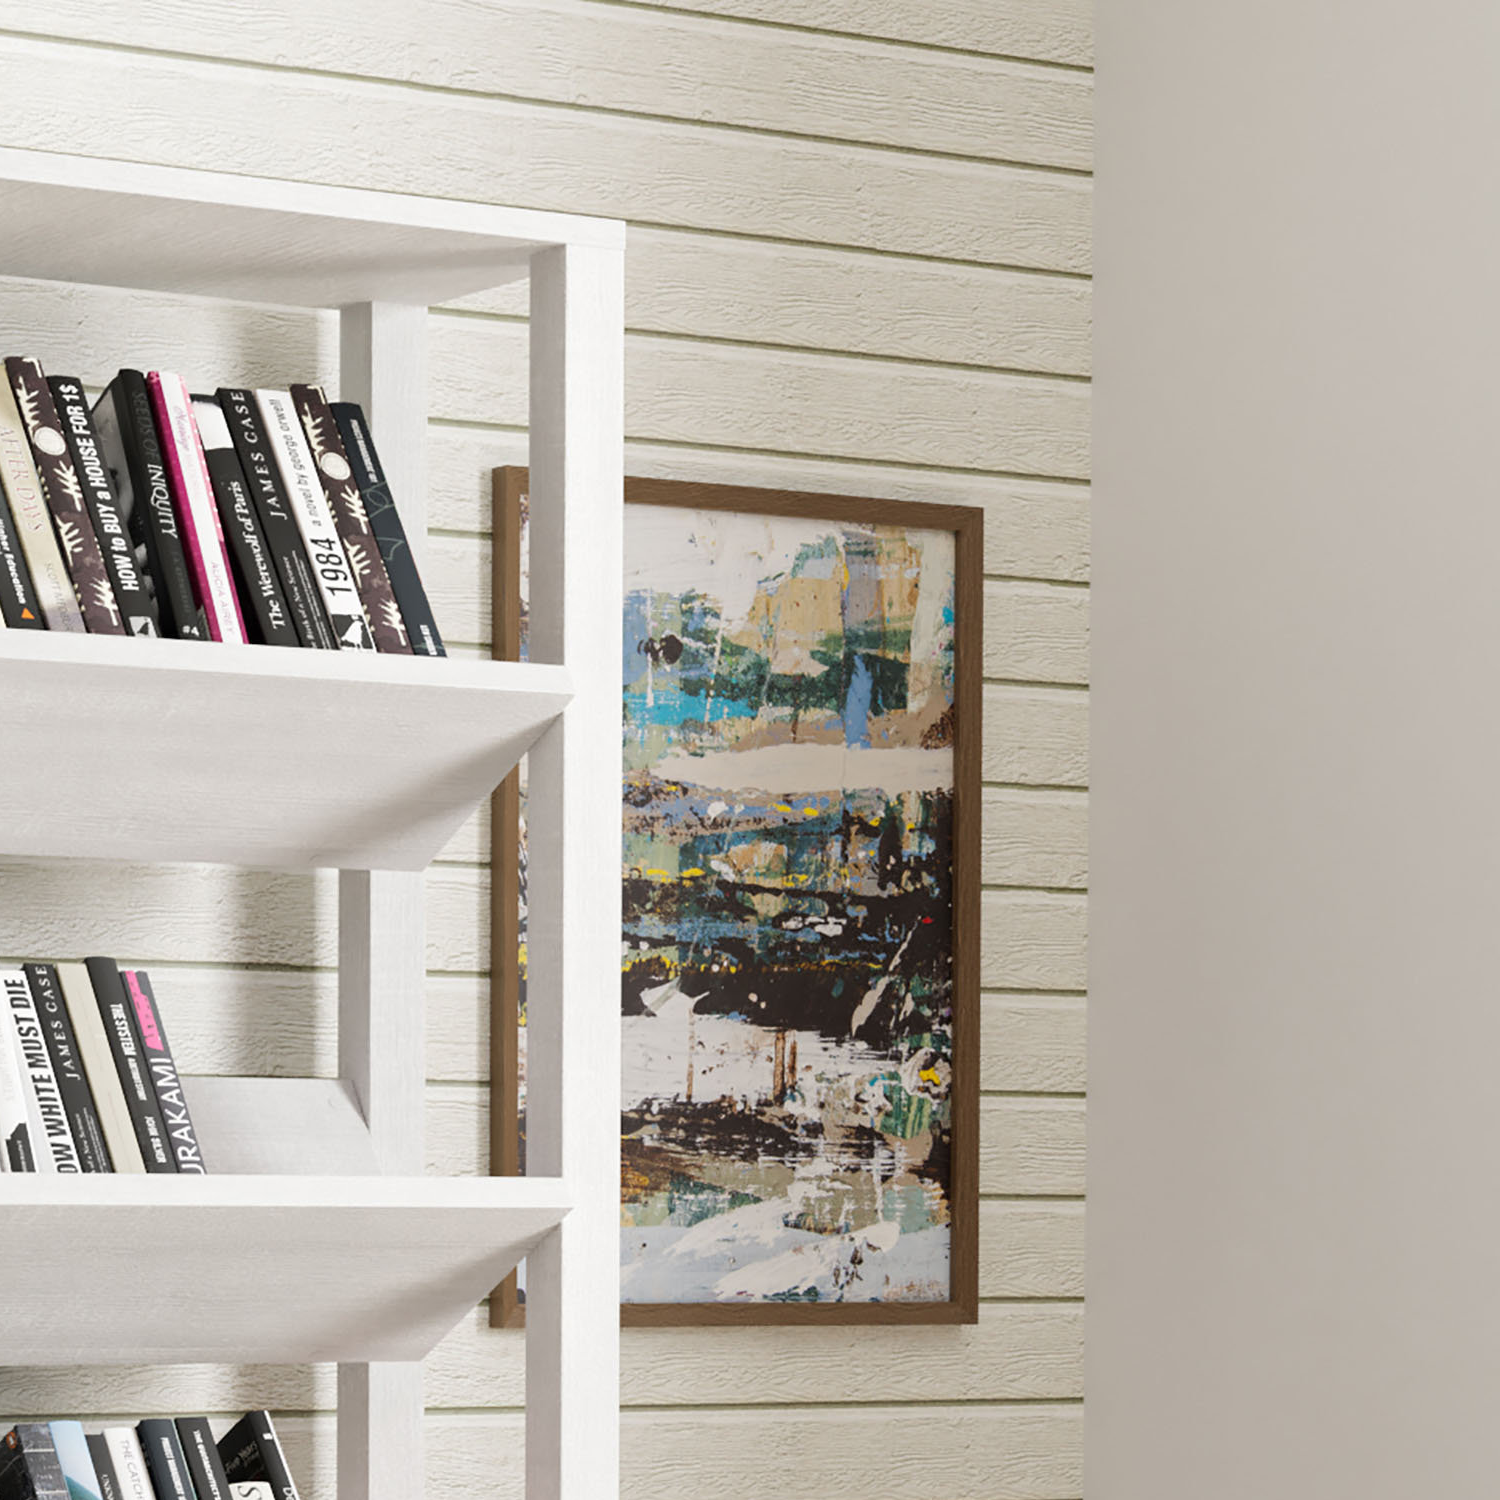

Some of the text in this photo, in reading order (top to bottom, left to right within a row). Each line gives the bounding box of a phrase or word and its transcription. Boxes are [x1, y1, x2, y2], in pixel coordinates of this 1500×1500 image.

[268, 398, 291, 432] orwell
[282, 434, 306, 471] george
[0, 426, 46, 533] AFTER DAYS
[58, 384, 140, 591] HOW to BUY a HOUSE FOR 1$
[147, 463, 178, 539] INIQUITY
[250, 452, 288, 521] JAMES
[297, 474, 308, 486] by
[298, 487, 318, 517] novel
[311, 519, 322, 527] a
[7, 553, 26, 604] Education
[227, 481, 286, 630] The Werewolf of Paris
[309, 538, 352, 596] 1984
[293, 586, 302, 602] New
[3, 979, 31, 1009] DIE
[13, 1013, 48, 1069] MUST
[50, 1020, 81, 1081] JAMES
[30, 1074, 67, 1138] WHITE
[120, 1440, 135, 1461] THE
